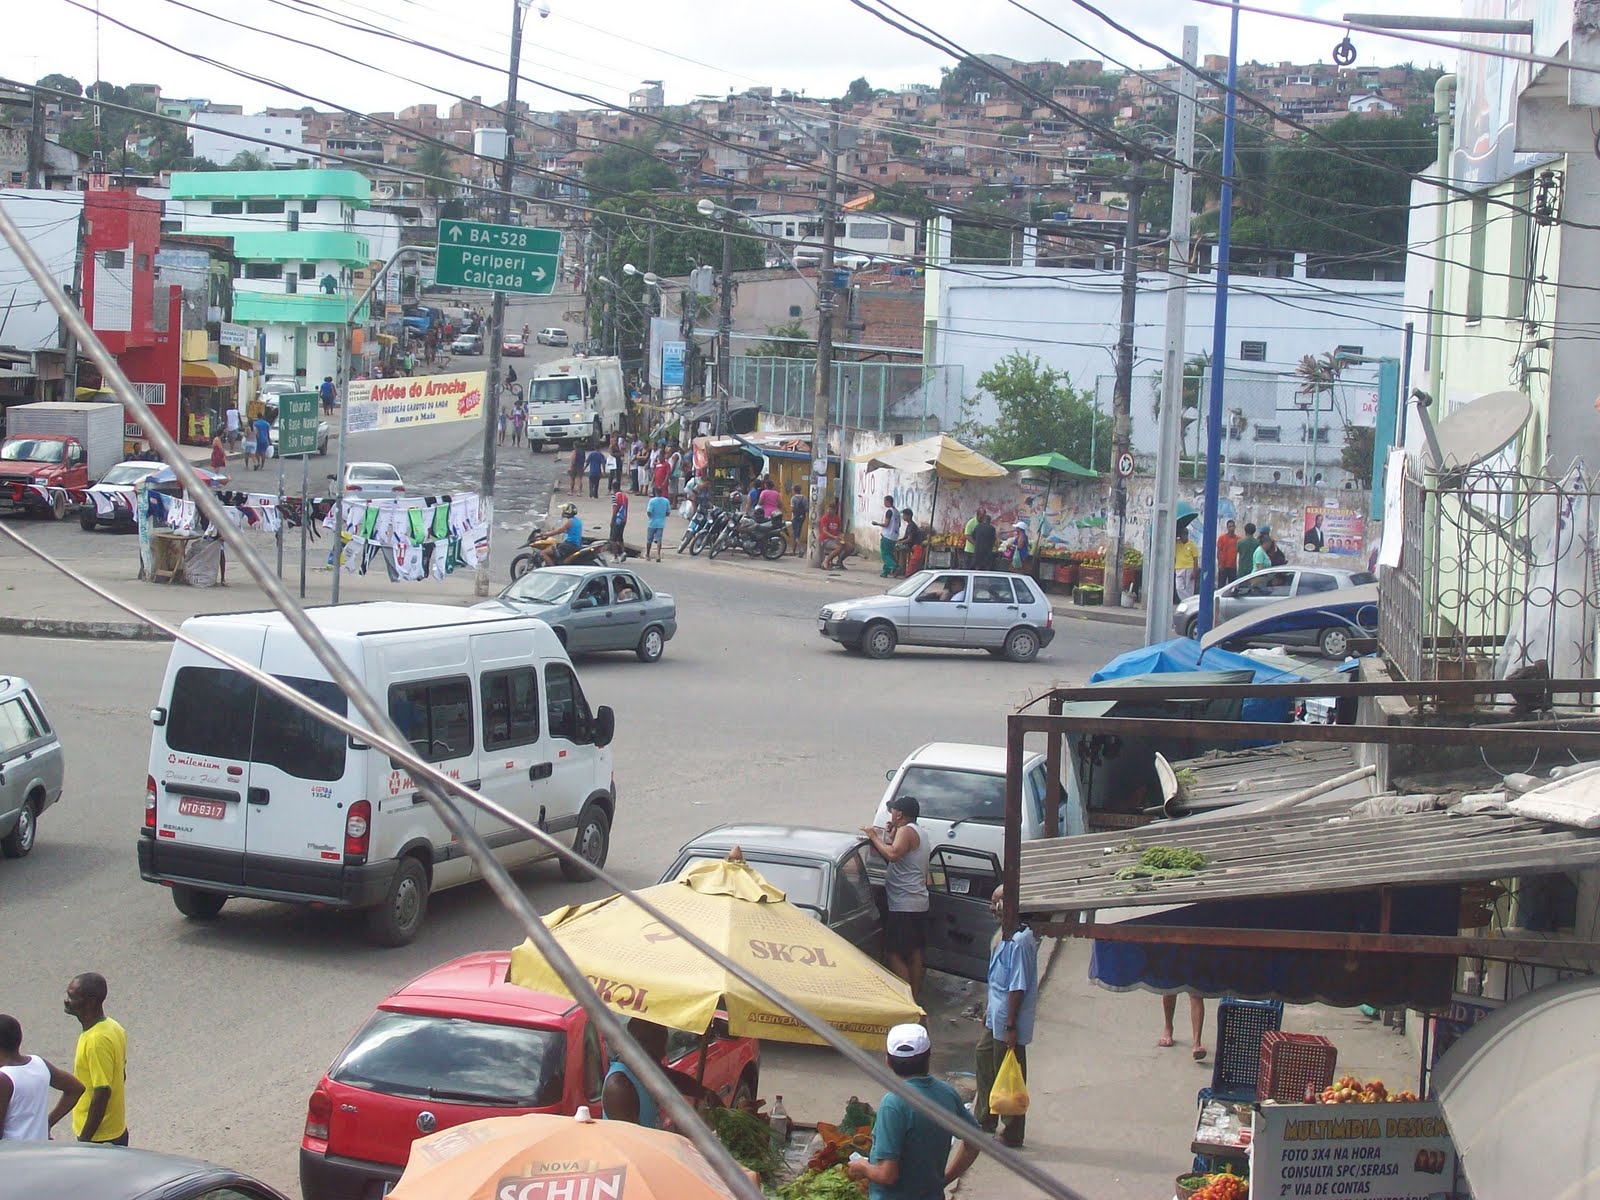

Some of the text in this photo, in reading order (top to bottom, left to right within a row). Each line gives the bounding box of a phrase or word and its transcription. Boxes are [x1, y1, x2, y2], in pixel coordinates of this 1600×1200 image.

[470, 229, 527, 246] BA-528
[462, 252, 526, 270] Periperi
[464, 269, 523, 288] Calçada
[370, 378, 467, 401] Aviões do Arrocha
[289, 418, 301, 430] Base
[394, 415, 414, 424] Amor
[420, 412, 436, 420] Mais
[178, 756, 220, 769] milenium
[163, 824, 194, 832] RENAULT
[749, 939, 837, 967] SKOL
[748, 1012, 756, 1023] A
[758, 1014, 799, 1027] CERVEJA
[340, 1103, 358, 1113] GOL
[1283, 1116, 1381, 1141] MULTIMIDIA
[1282, 1146, 1381, 1162] FOTO 3X4 NA HORA
[540, 1161, 580, 1172] NOVA
[1281, 1163, 1399, 1179] CONSULTA SPC/SERASA
[499, 1174, 621, 1200] SCHIN
[1295, 1183, 1312, 1196] VIA
[1315, 1182, 1329, 1195] DE
[1331, 1181, 1371, 1194] CONTAS
